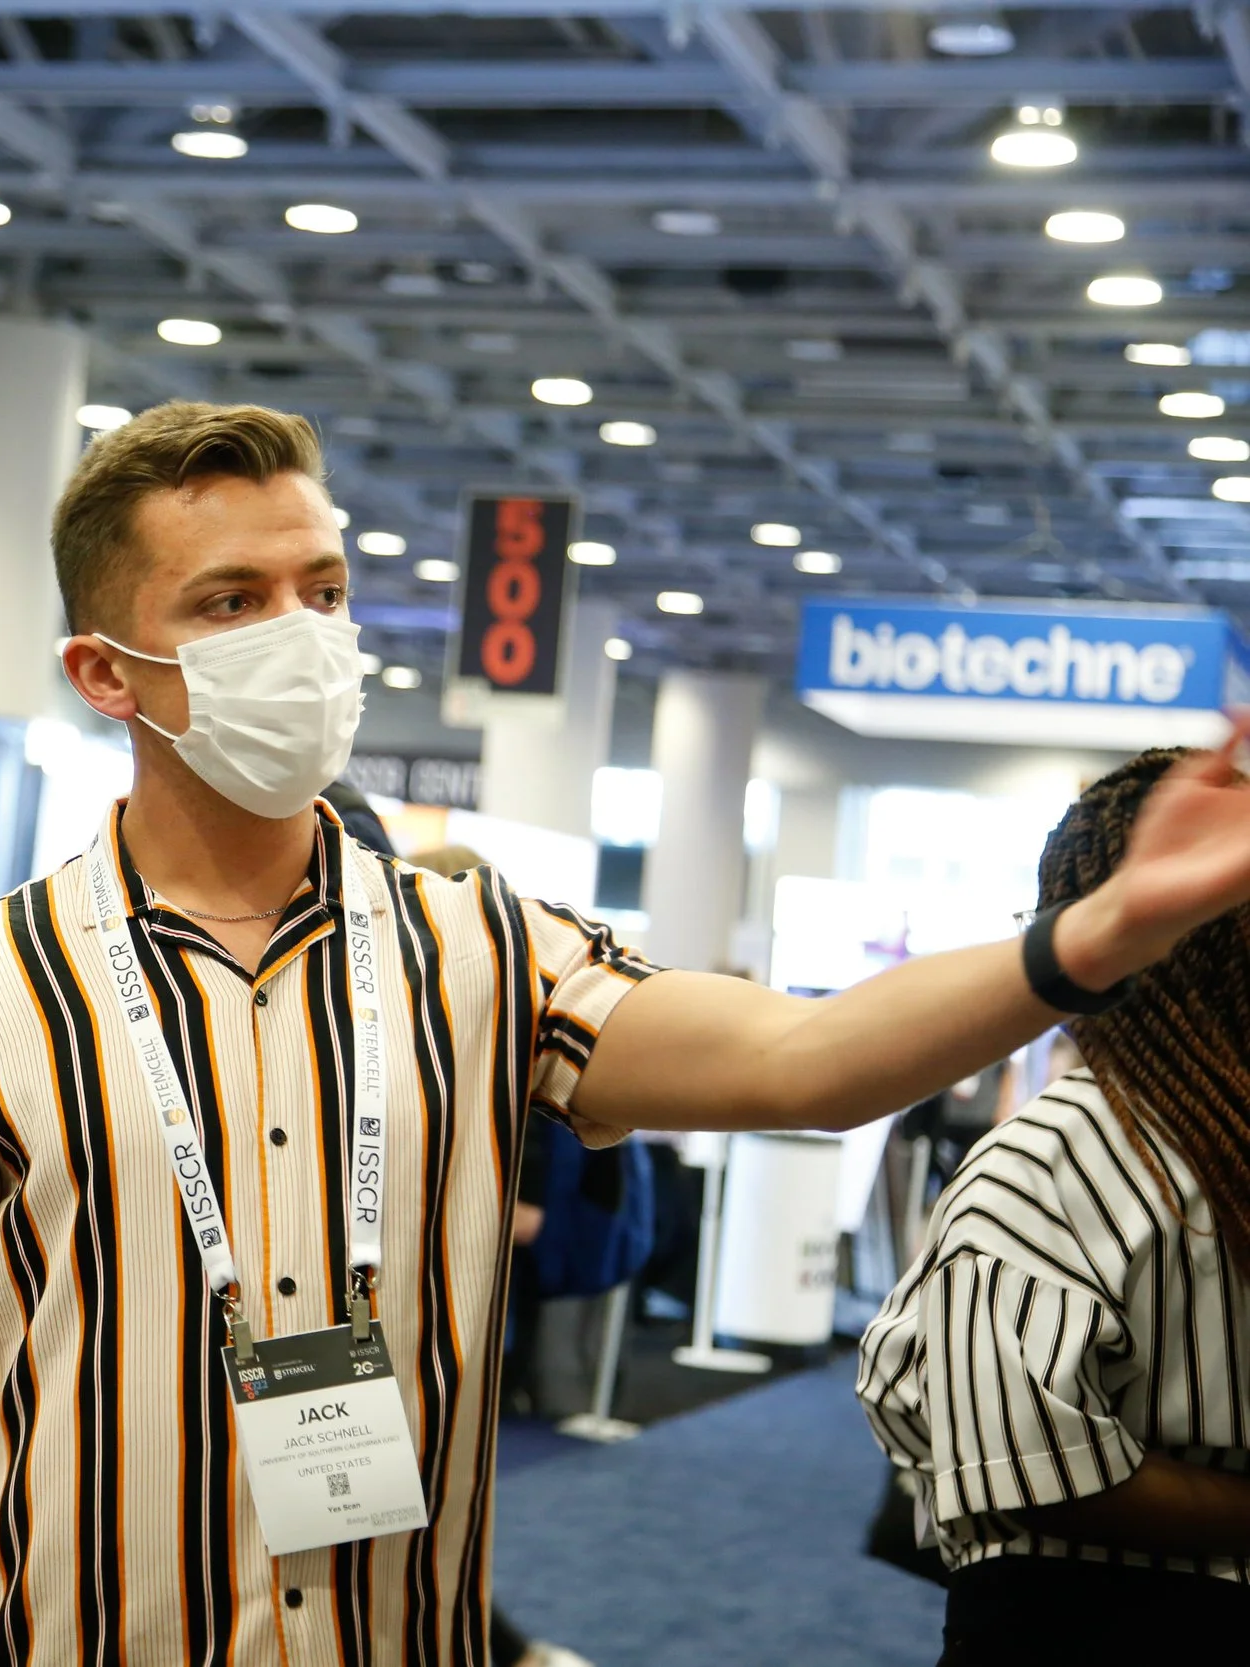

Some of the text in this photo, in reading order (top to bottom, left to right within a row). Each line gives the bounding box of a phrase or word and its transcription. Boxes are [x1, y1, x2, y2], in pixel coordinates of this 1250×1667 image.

[482, 497, 545, 685] 500
[828, 613, 1188, 703] biotechne
[92, 861, 113, 918] STEMCELL
[109, 941, 144, 1003] ISSCR
[351, 931, 374, 994] ISSCR
[141, 1038, 174, 1108] STEMCELL
[364, 1023, 380, 1092] STEMCELL
[174, 1142, 215, 1222] ISSCR
[356, 1144, 380, 1224] ISSCR
[238, 1367, 266, 1382] ISSCR
[282, 1365, 316, 1377] STEMCELL
[357, 1346, 380, 1357] ISSCR
[284, 1424, 373, 1450] JACK SCHNELL
[298, 1402, 350, 1425] JACK
[259, 1451, 296, 1466] UNIVERSITY
[298, 1450, 307, 1459] OF
[309, 1445, 343, 1458] SOUTHERN
[344, 1438, 382, 1451] CALIFORNIA
[298, 1456, 372, 1478] UNITED STATES
[327, 1503, 361, 1513] Yes Scan
